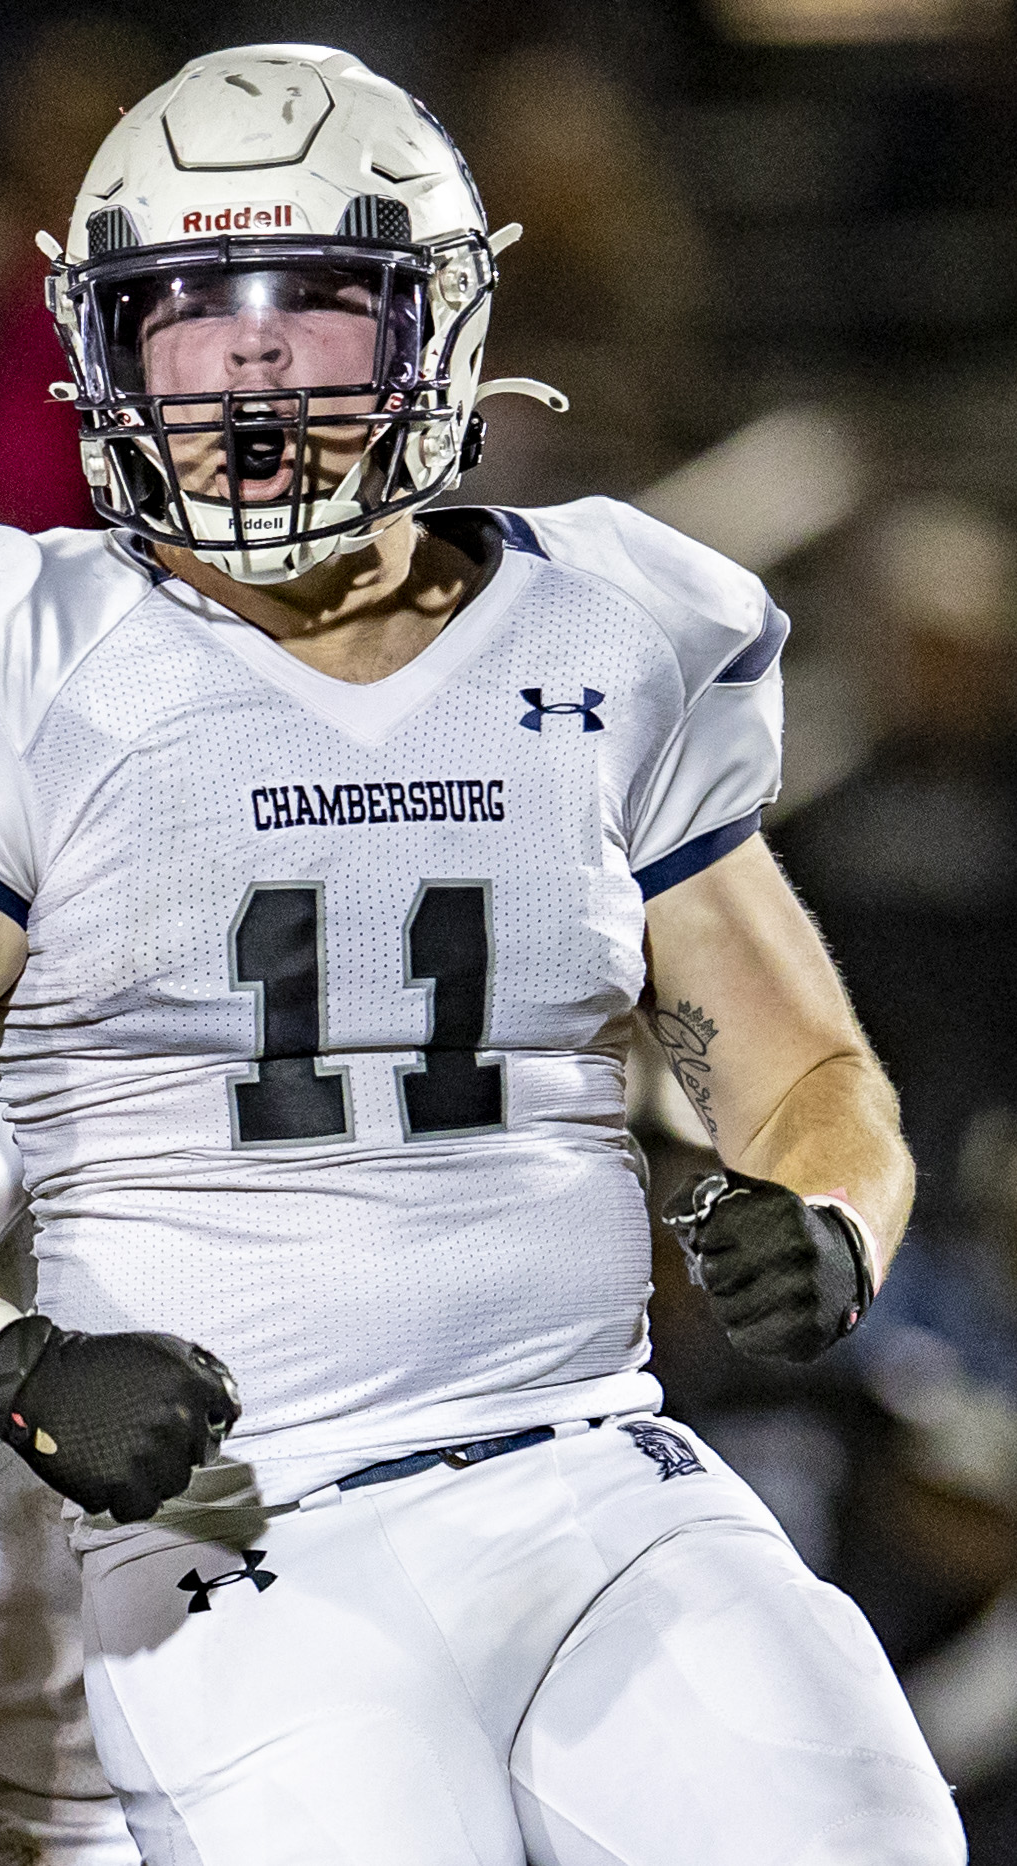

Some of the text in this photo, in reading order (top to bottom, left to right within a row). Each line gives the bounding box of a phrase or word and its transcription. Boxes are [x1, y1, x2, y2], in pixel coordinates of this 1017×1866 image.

[183, 205, 292, 233] Riddell
[228, 517, 283, 530] Rddell
[251, 780, 505, 831] CHAMBERSBURG
[226, 877, 508, 1151] 11
